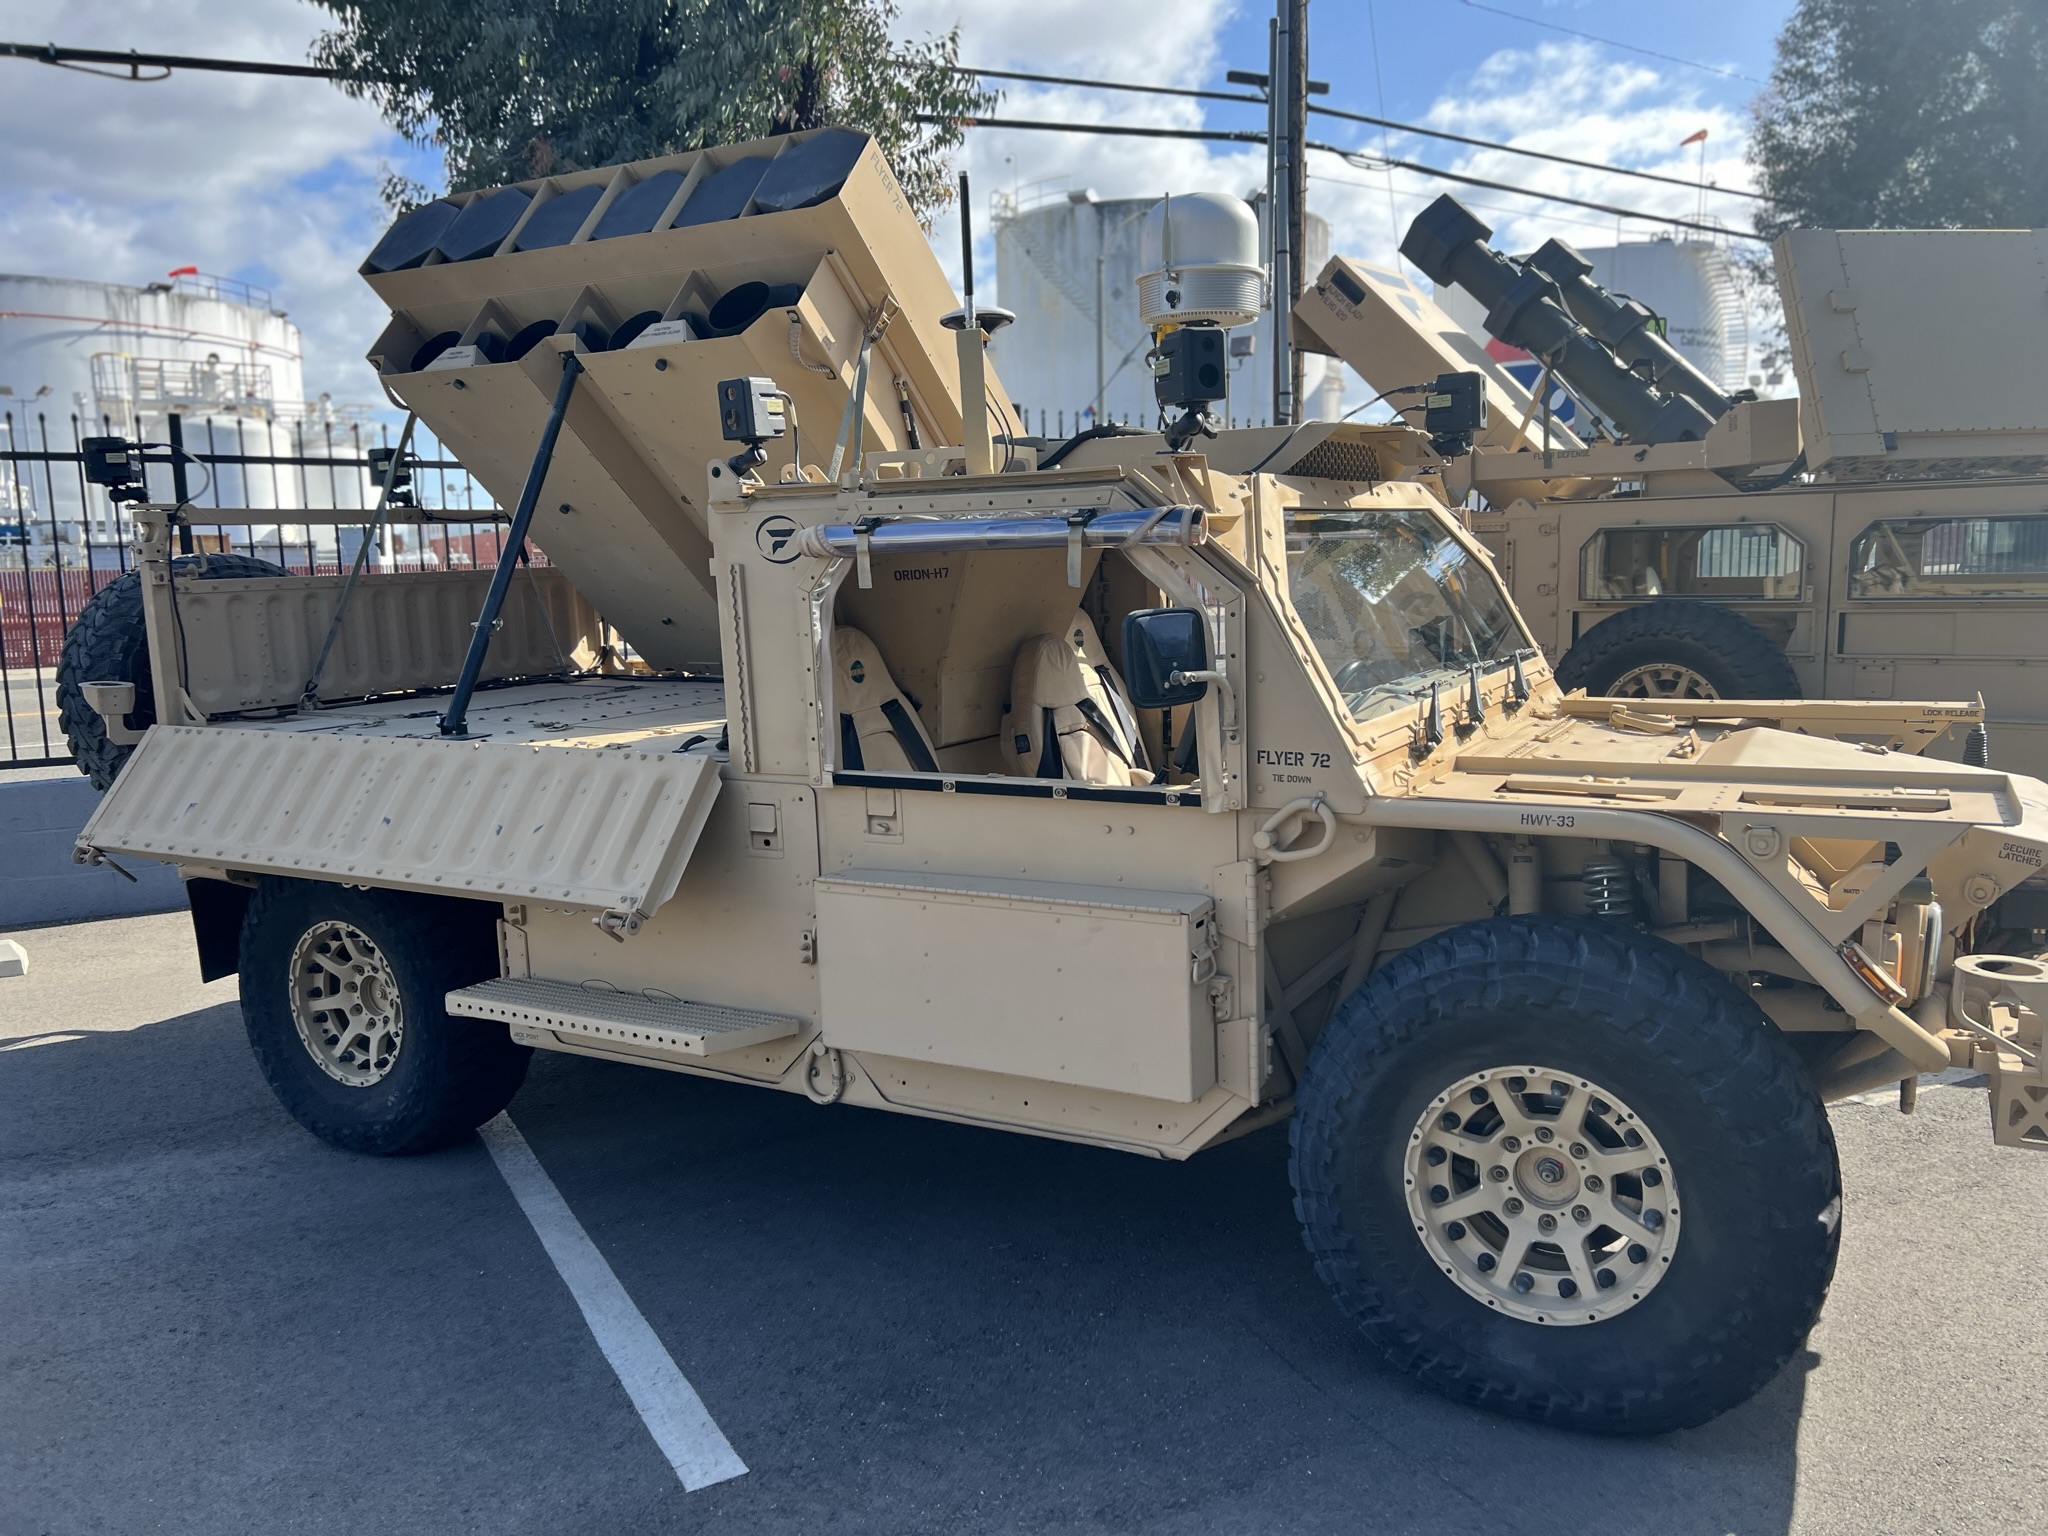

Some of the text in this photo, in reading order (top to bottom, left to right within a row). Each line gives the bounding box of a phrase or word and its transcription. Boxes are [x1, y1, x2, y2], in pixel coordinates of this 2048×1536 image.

[870, 151, 903, 214] FLYER 72
[1344, 302, 1365, 321] READY
[1533, 451, 1555, 461] FLR
[894, 567, 949, 581] ORION-H7
[1922, 709, 1980, 718] LOCK RELEASE
[1257, 749, 1331, 769] FLYER 72
[1272, 773, 1312, 784] TIE DOWN
[1520, 813, 1575, 828] HWY-33
[2003, 842, 2042, 858] SECURE
[1998, 850, 2042, 867] LATCHES
[526, 1033, 540, 1041] POINT
